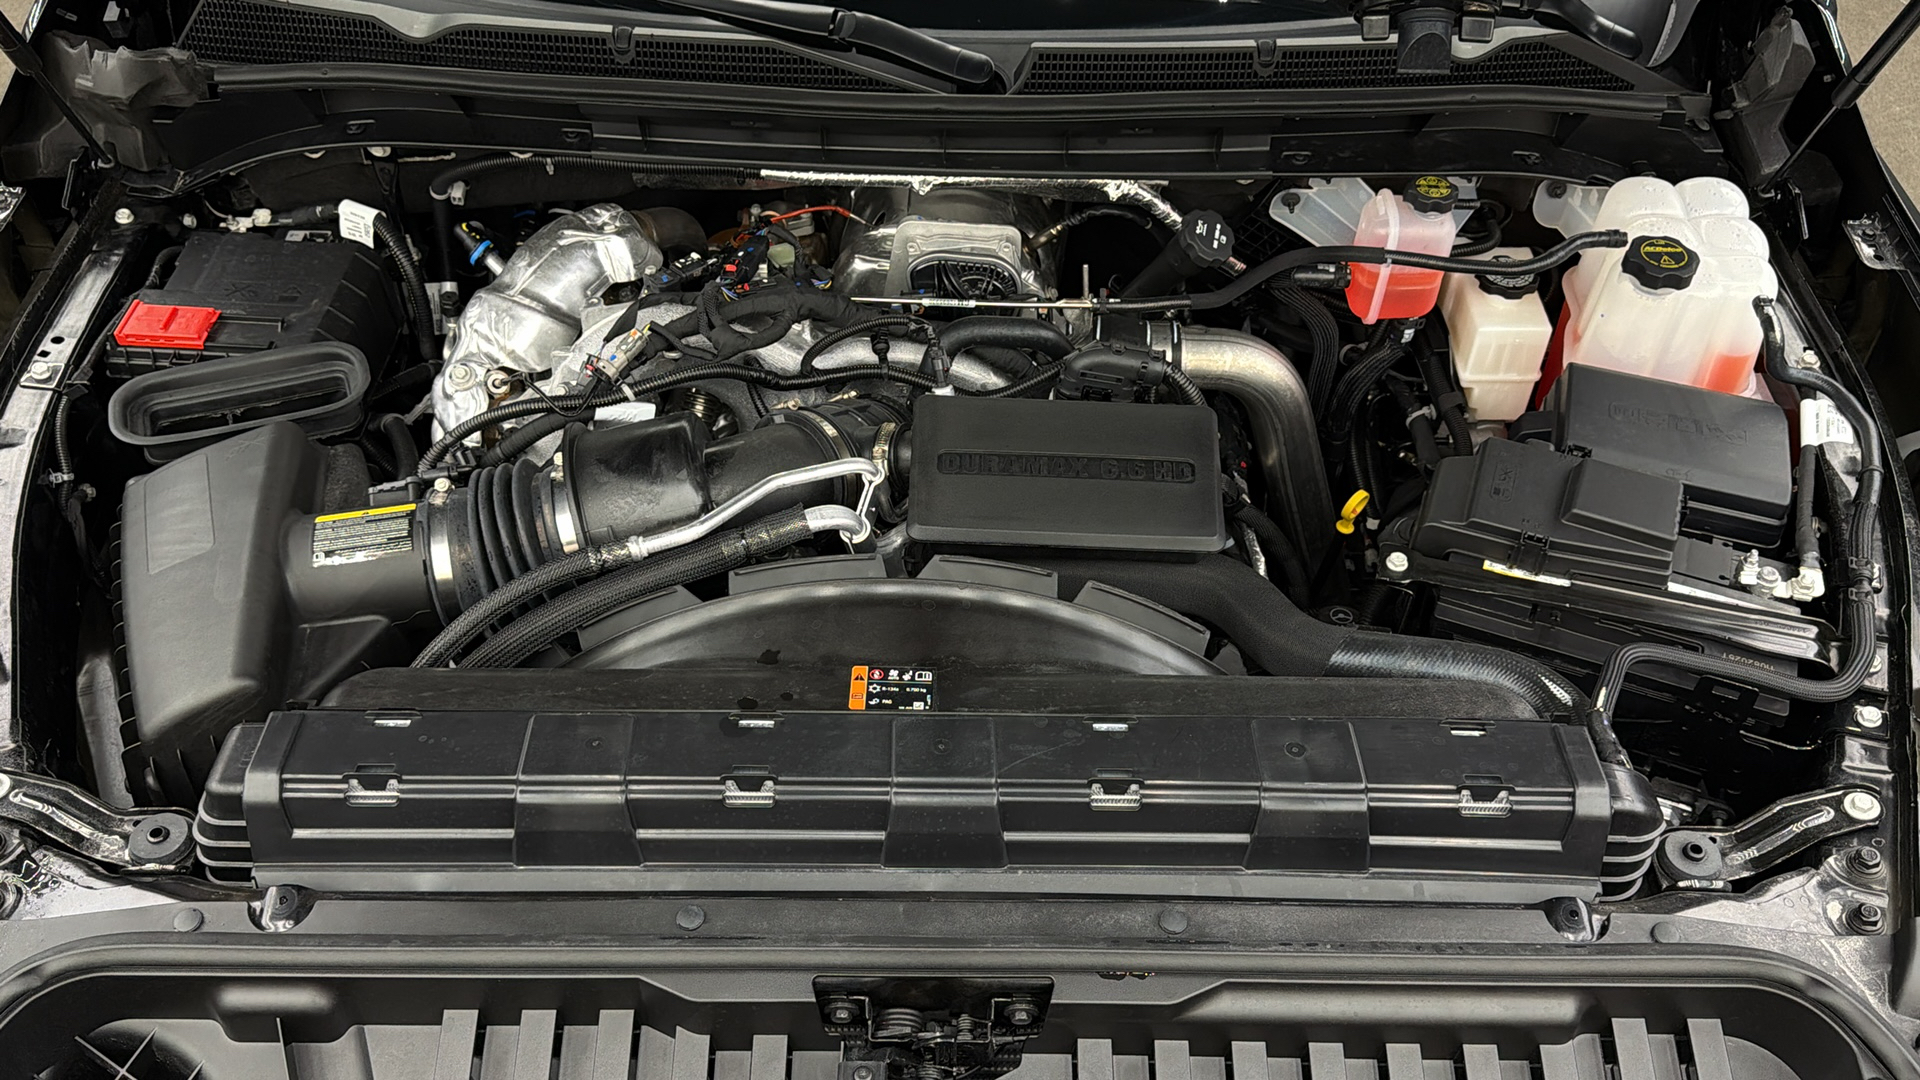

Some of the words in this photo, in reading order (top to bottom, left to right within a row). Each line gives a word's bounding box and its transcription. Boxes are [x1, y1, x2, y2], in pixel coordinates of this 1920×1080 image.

[941, 453, 1089, 478] DURAMAX
[1100, 458, 1146, 480] 6.6
[1153, 461, 1193, 482] HD
